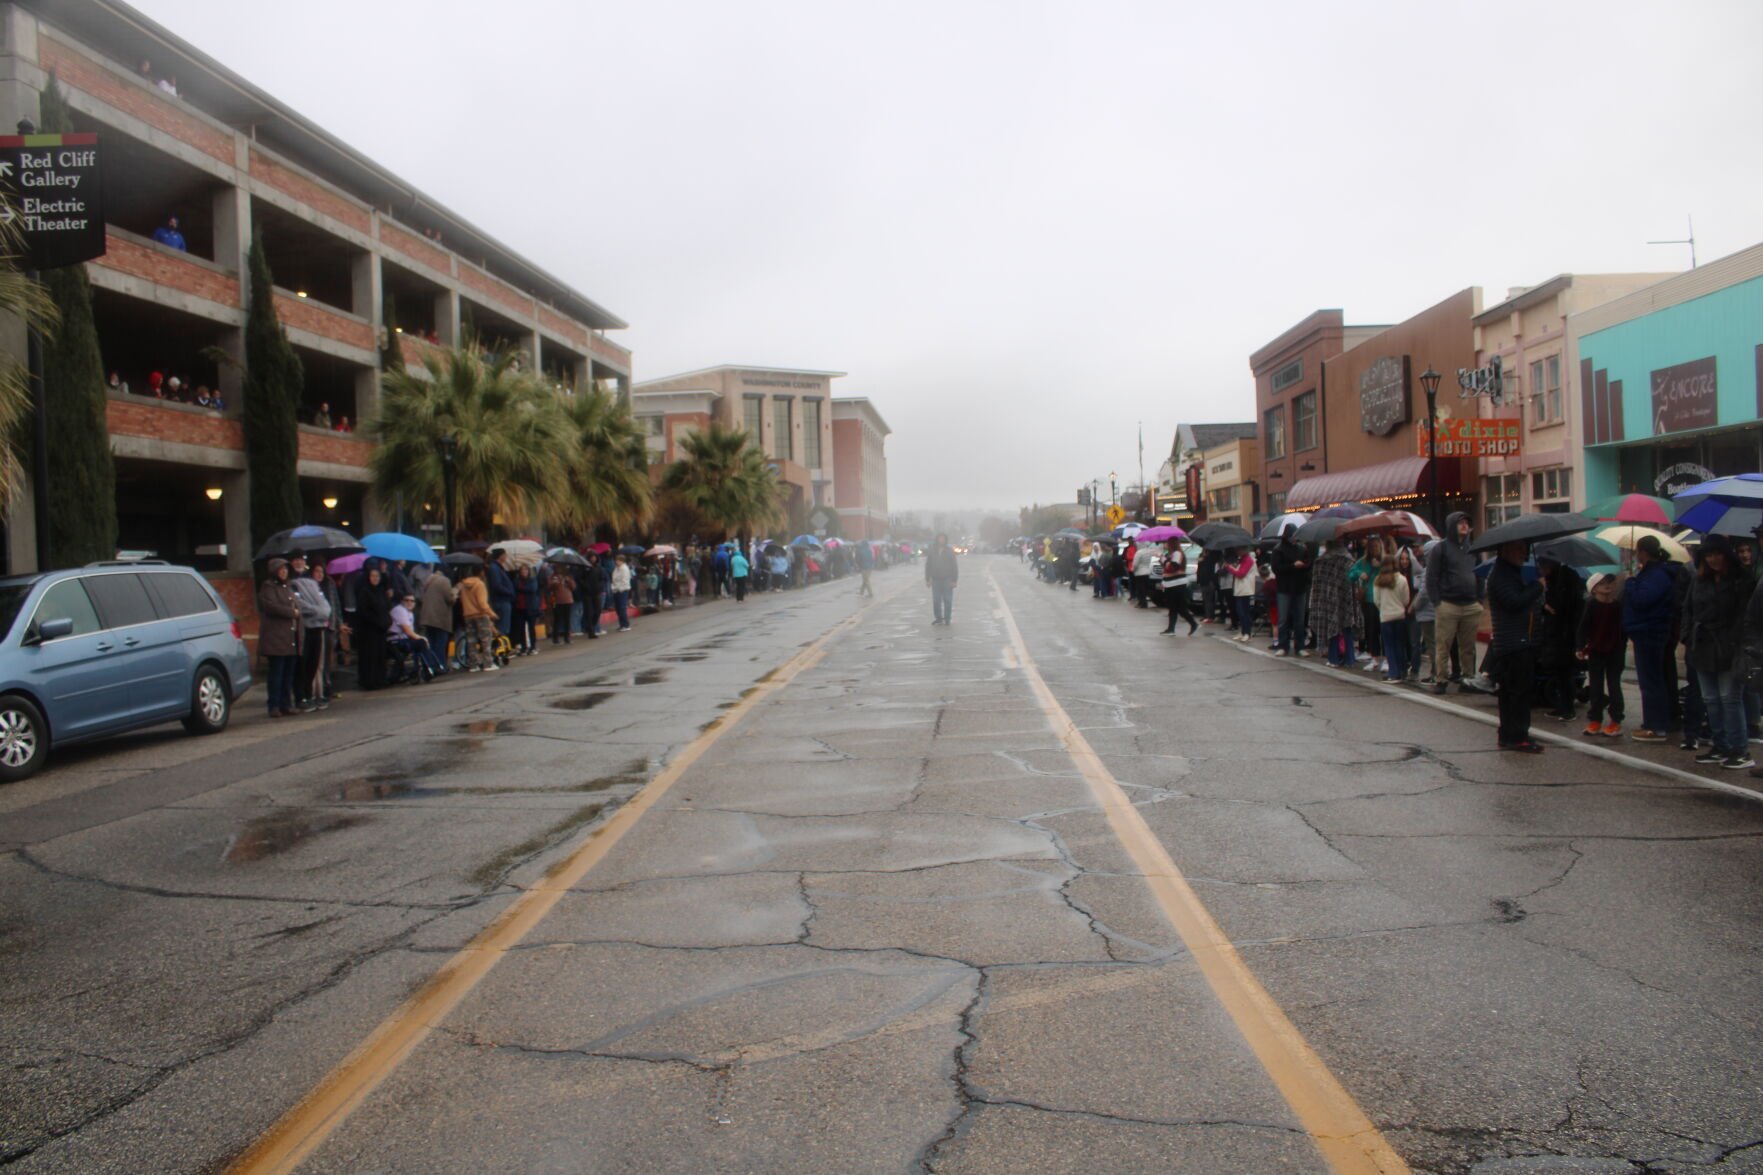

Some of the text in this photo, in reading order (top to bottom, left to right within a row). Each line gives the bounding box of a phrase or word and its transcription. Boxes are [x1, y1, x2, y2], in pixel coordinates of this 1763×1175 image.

[20, 151, 96, 169] Red Cliff
[21, 171, 81, 188] Gallery
[23, 198, 86, 214] Electric
[24, 215, 88, 231] Theater
[1459, 419, 1519, 438] dixie
[1479, 439, 1519, 455] SHOP
